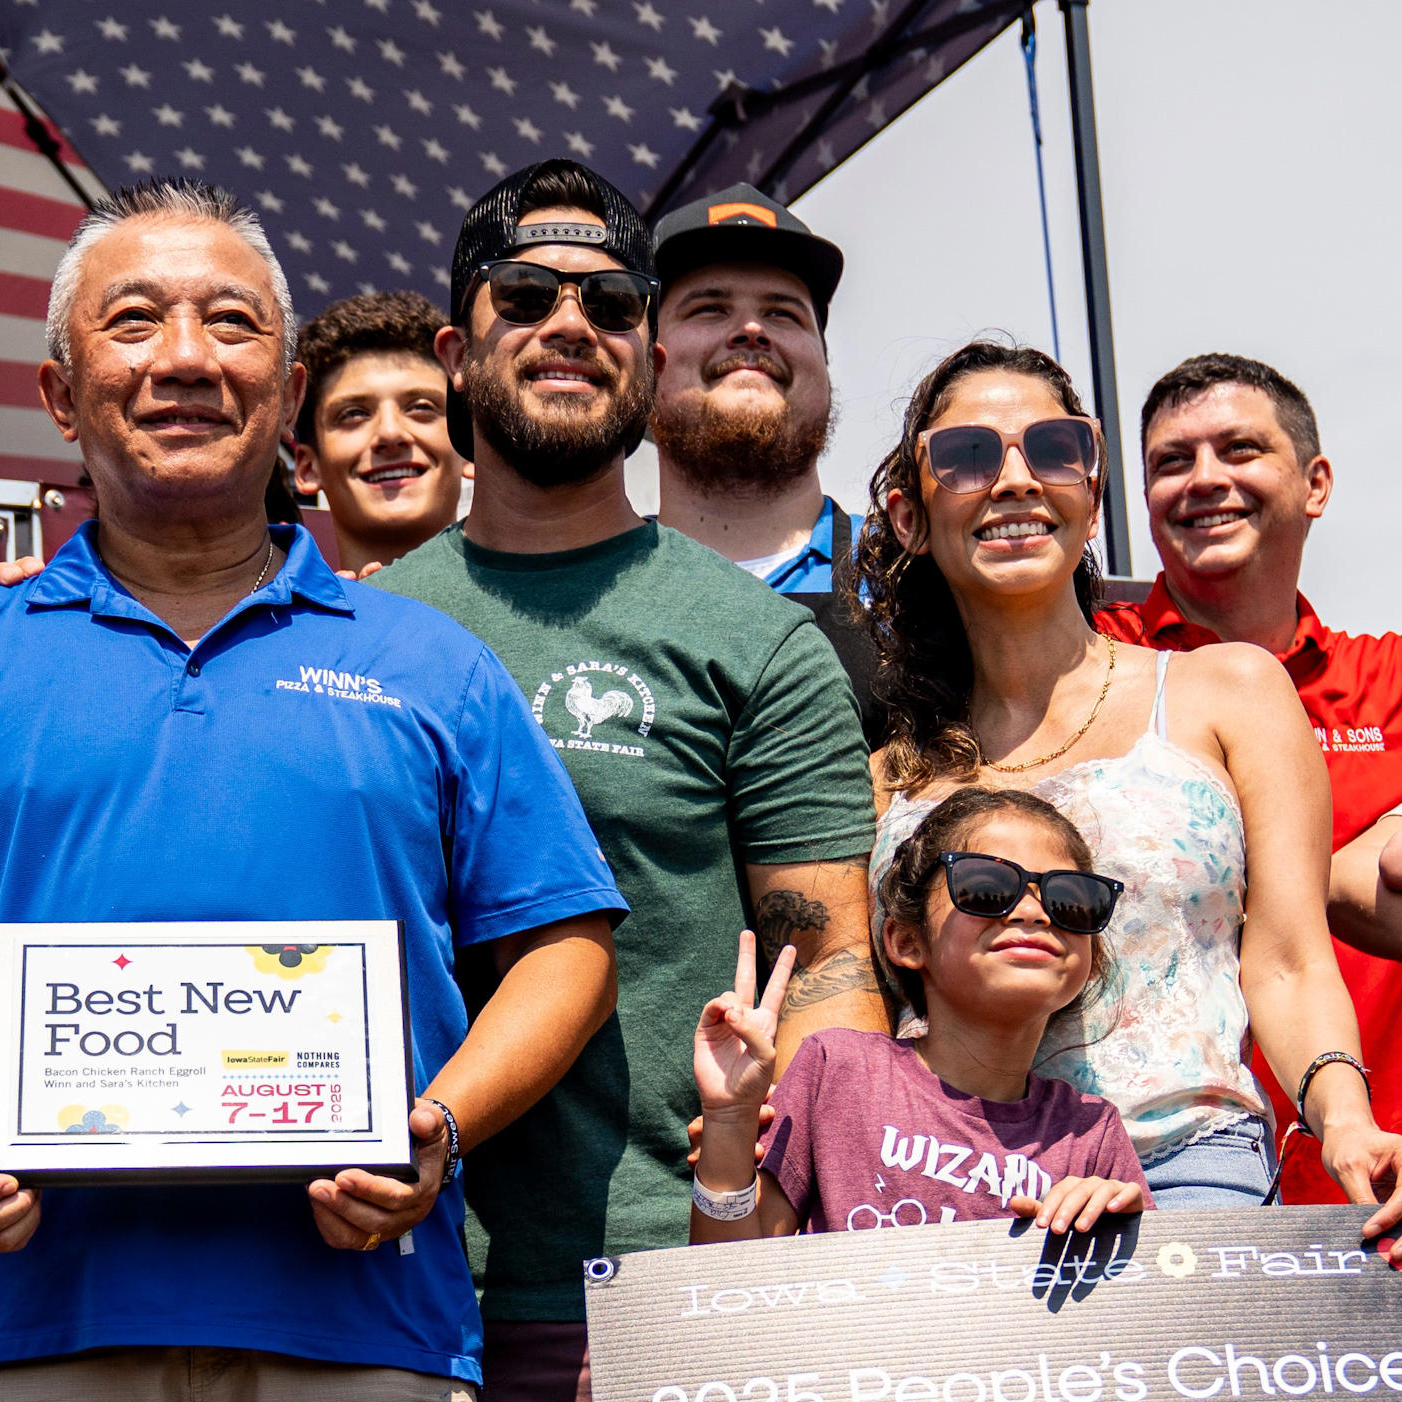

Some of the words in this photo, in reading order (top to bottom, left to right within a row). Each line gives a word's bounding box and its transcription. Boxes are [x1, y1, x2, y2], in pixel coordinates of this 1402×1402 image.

[299, 665, 382, 694] WINN'S
[276, 680, 310, 692] PIZZA
[314, 684, 324, 693] &
[327, 687, 402, 708] STEAKHOUSE
[551, 672, 564, 682] &
[566, 661, 628, 676] SARA'S
[627, 673, 655, 737] KITCHEN
[1332, 729, 1342, 743] &
[1347, 727, 1383, 743] SONS
[567, 740, 610, 752] STATE
[612, 745, 645, 757] FAIR
[1332, 743, 1385, 752] STEAKHOUSE
[45, 983, 165, 1015] Best
[180, 982, 302, 1014] New
[44, 1023, 182, 1056] Food
[297, 1052, 340, 1060] NOTHING
[297, 1061, 340, 1069] COMPARES
[44, 1067, 78, 1077] Bacon
[82, 1067, 126, 1077] Chicken
[131, 1067, 165, 1076] Ranch
[169, 1066, 207, 1078] Eggroll
[44, 1079, 72, 1088] Winn
[75, 1079, 96, 1088] and
[100, 1079, 133, 1088] Sara's
[137, 1079, 179, 1088] Kitchen
[221, 1084, 326, 1097] AUGUST
[330, 1084, 342, 1123] 2025
[880, 1125, 1052, 1209] WIZARD
[678, 1279, 866, 1317] Iowa
[929, 1255, 1147, 1295] State
[1207, 1244, 1368, 1279] Fair
